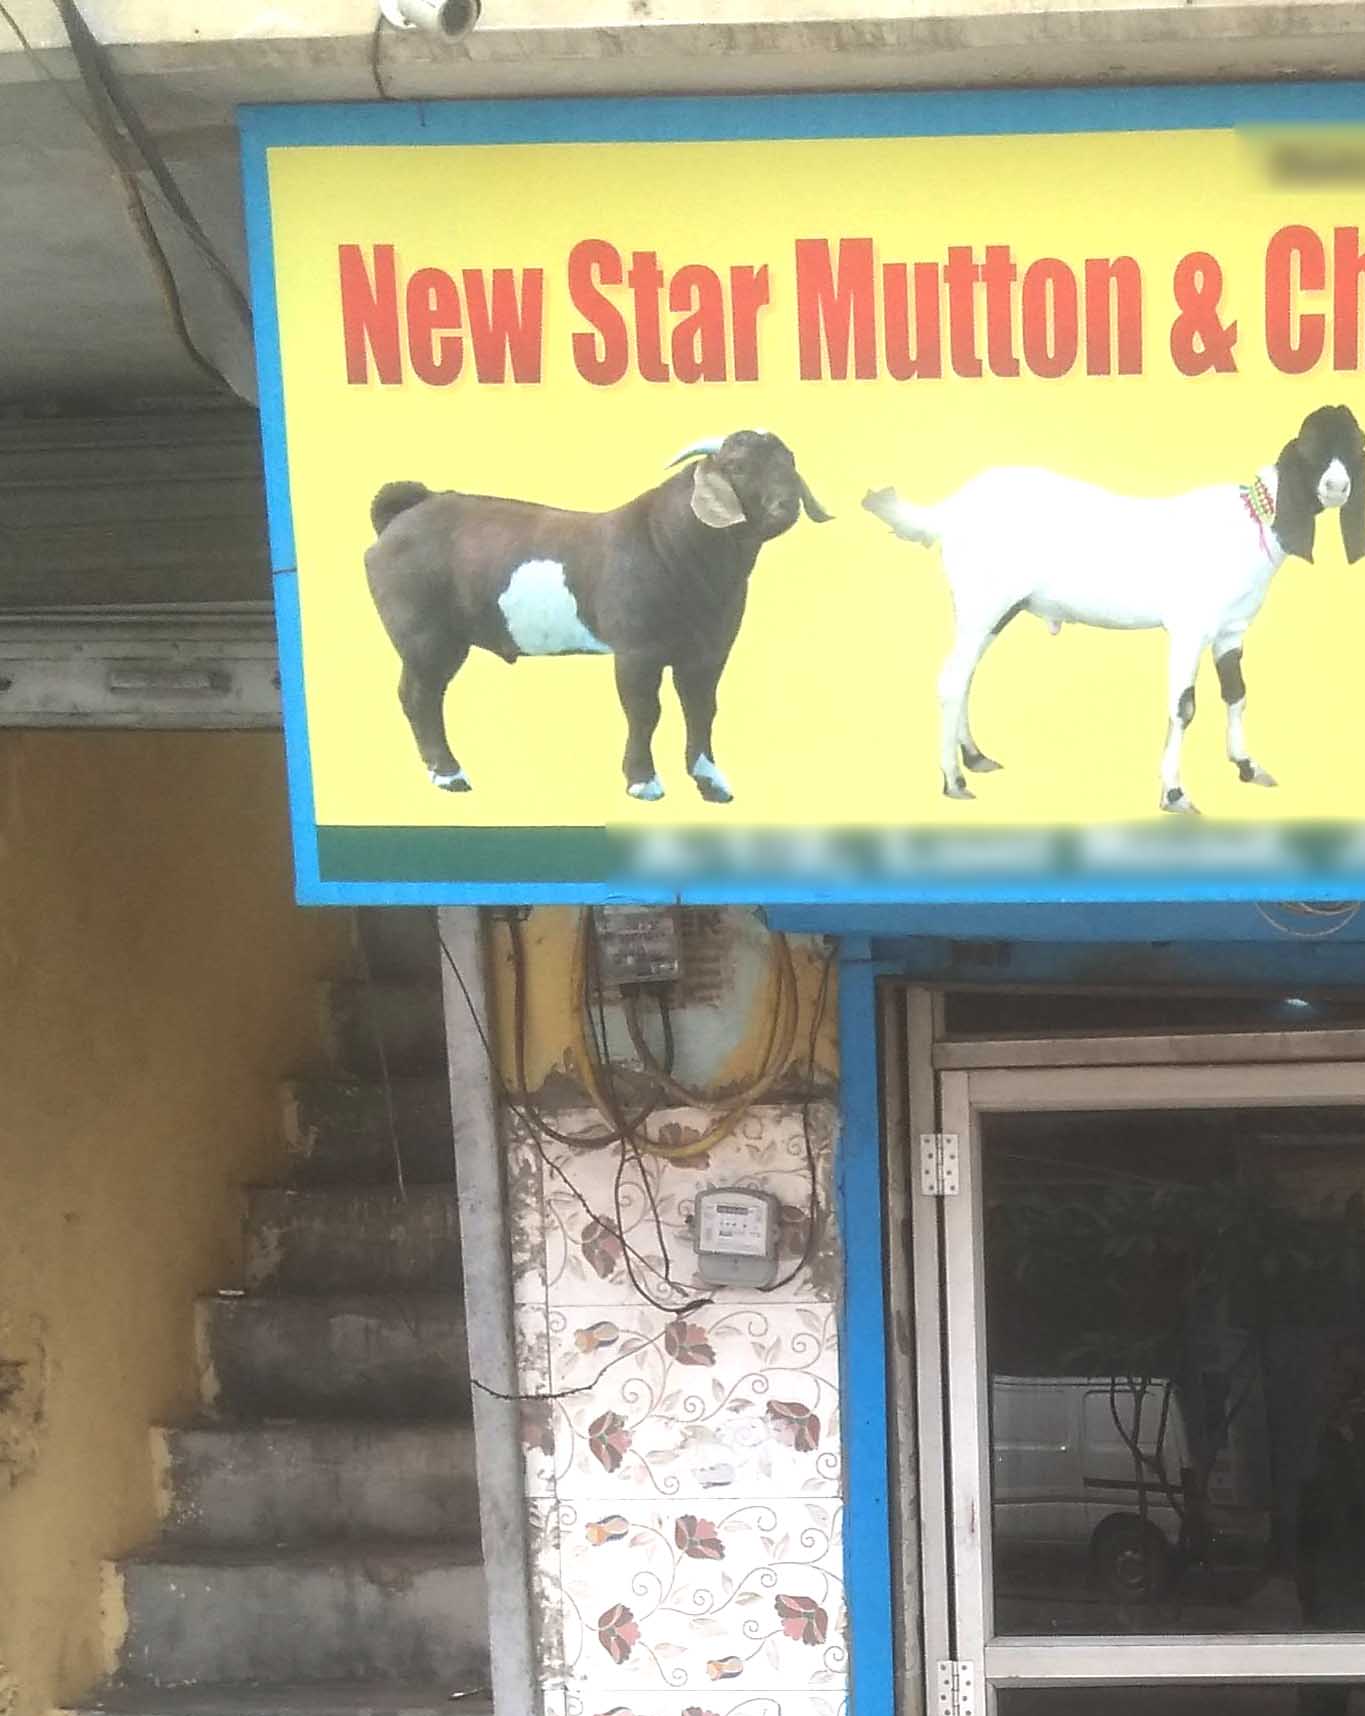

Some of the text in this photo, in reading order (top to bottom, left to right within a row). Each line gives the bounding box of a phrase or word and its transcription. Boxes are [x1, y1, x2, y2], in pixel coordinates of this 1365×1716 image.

[338, 243, 545, 386] New
[567, 238, 770, 386] Star
[795, 237, 1143, 381] Mutton
[1169, 251, 1238, 377] &
